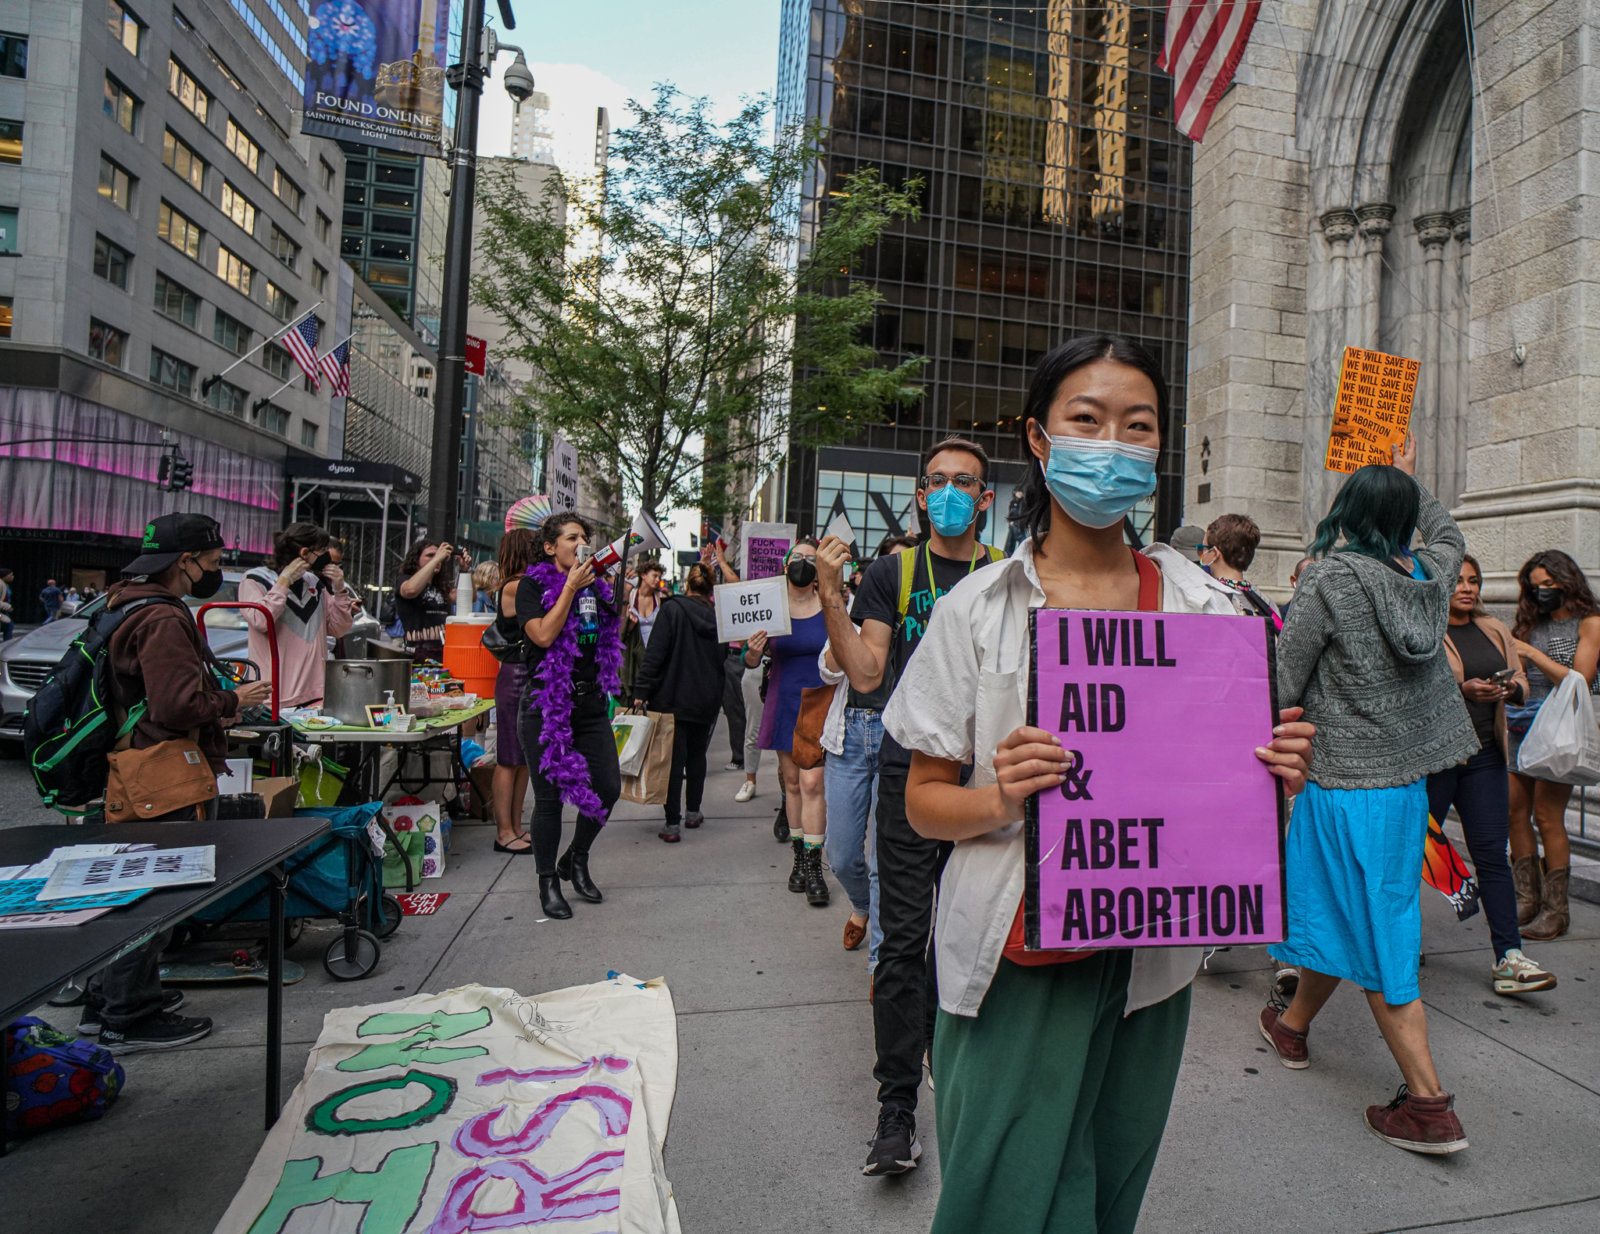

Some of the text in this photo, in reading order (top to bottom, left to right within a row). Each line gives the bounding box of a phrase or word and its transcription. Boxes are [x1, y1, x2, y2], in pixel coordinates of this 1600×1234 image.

[315, 91, 433, 127] FOUND ONLINE
[361, 130, 388, 140] LIGHT
[1347, 359, 1416, 382] WE WILL SAVE US
[1349, 348, 1418, 371] WE WILL SAVE US
[1345, 370, 1414, 393] WE WILL SAVE US
[1341, 392, 1354, 403] WE
[1356, 396, 1374, 408] WILL
[1376, 400, 1397, 412] SAVE
[1399, 404, 1410, 415] US
[1343, 382, 1412, 404] WE WILL SAVE US
[1339, 404, 1352, 414] WE
[1375, 411, 1394, 423] SAVE
[1396, 416, 1407, 426] US
[1352, 414, 1391, 437] ABORTION
[1334, 436, 1345, 447] WE
[1348, 440, 1366, 452] WILL
[1357, 428, 1378, 443] PILLS
[562, 453, 571, 471] WE
[1329, 459, 1341, 470] WE
[1331, 448, 1344, 459] WE
[1347, 451, 1364, 463] WILL
[328, 463, 355, 474] dyson
[557, 490, 575, 511] STOP
[752, 539, 775, 547] FUCK
[752, 547, 786, 557] SCOTUS
[740, 593, 760, 606] GET
[731, 609, 773, 625] FUCKED
[1058, 616, 1177, 667] I WILL
[1059, 683, 1126, 733] AID
[1060, 750, 1094, 801] &
[1061, 818, 1165, 871] ABET
[1061, 884, 1265, 942] ABORTION
